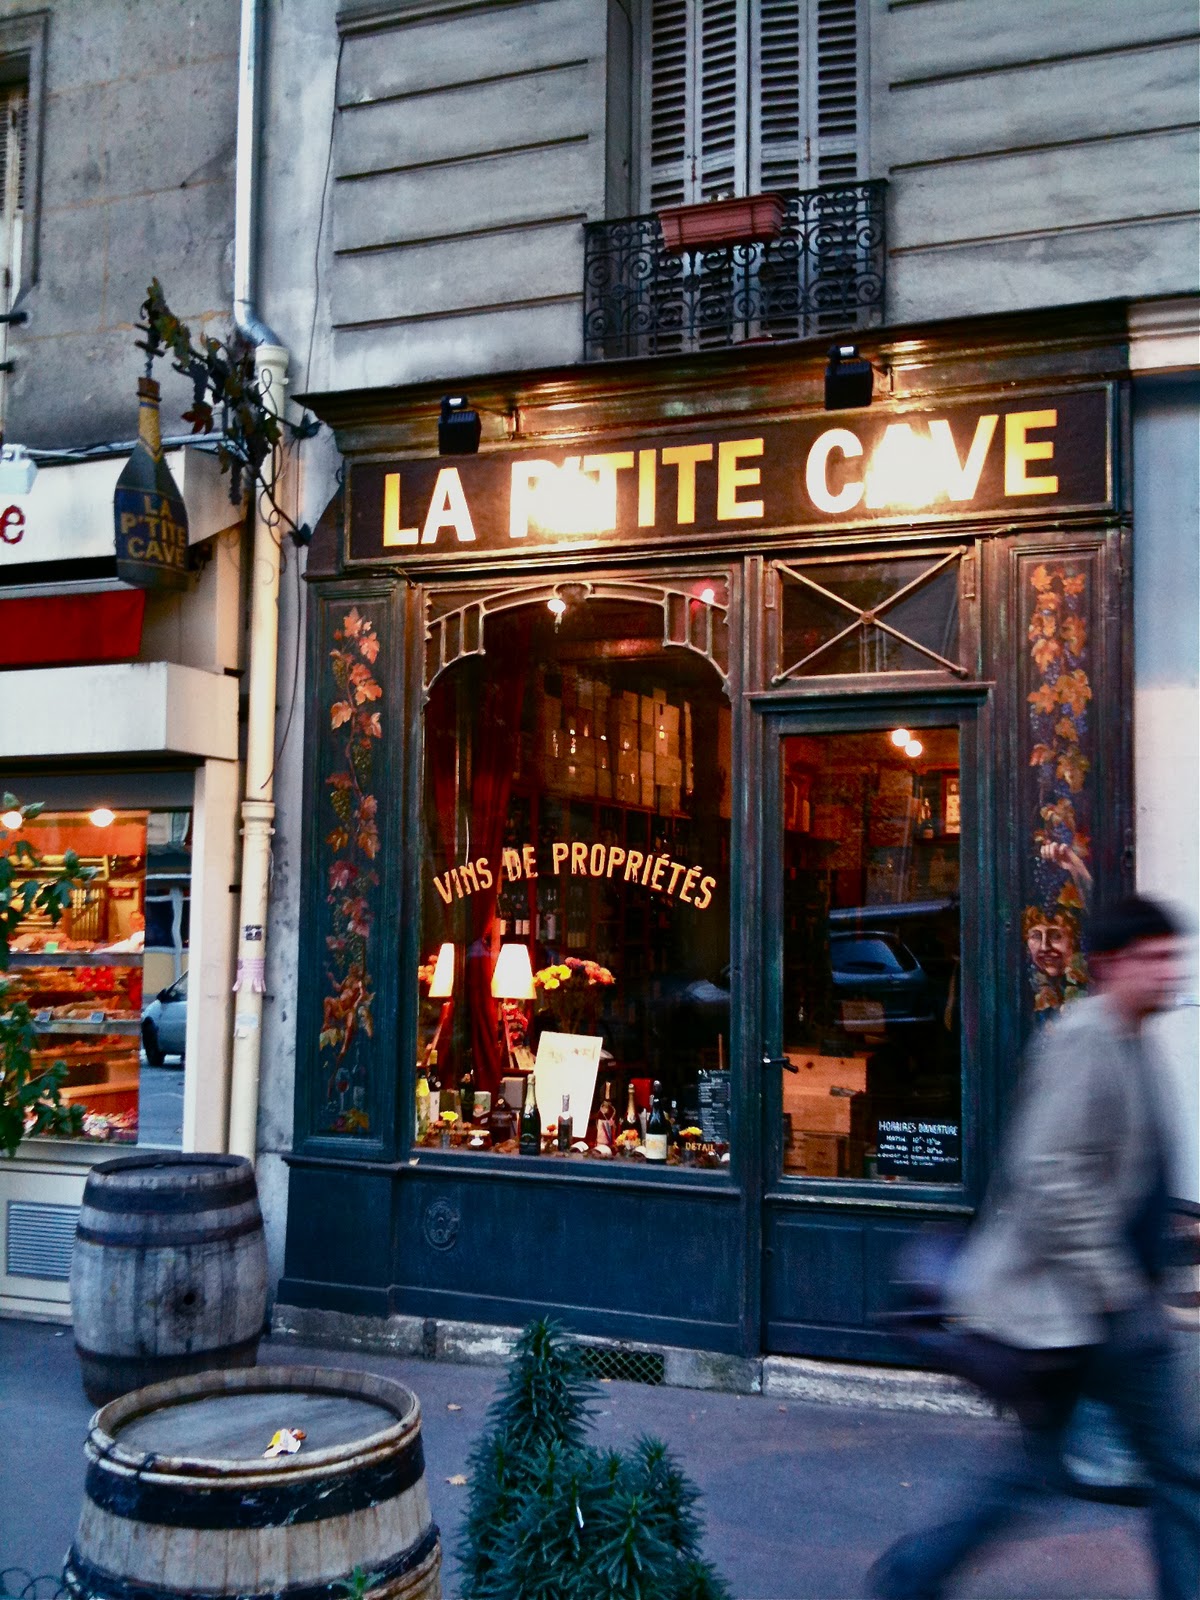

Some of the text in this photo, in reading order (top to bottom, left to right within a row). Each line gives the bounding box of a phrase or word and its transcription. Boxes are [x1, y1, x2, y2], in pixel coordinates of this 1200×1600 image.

[383, 467, 477, 547] LA
[805, 409, 1059, 514] CAVE
[144, 495, 172, 517] LA
[128, 537, 185, 566] CAVE
[433, 842, 717, 910] VINS DE PROPRIÉTÉS
